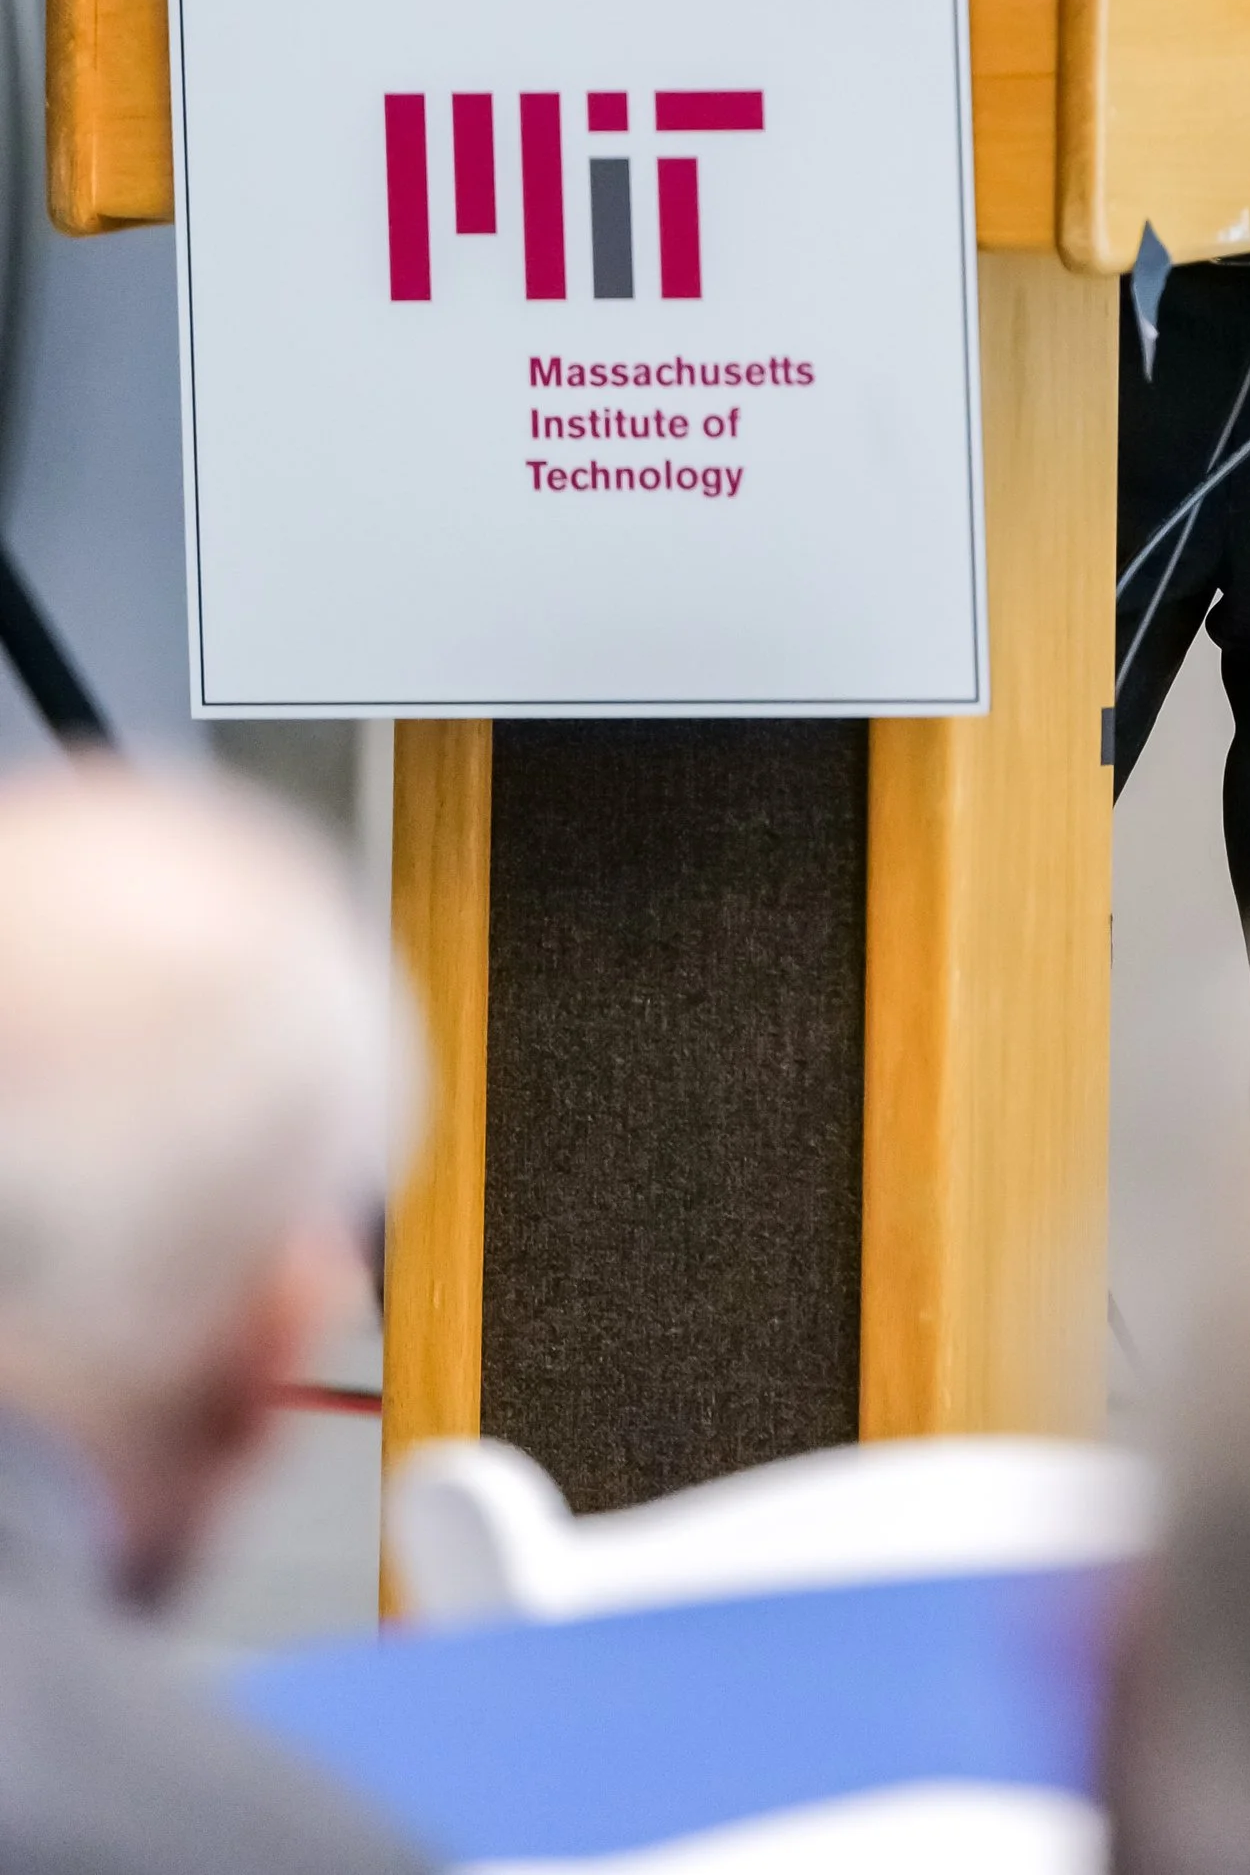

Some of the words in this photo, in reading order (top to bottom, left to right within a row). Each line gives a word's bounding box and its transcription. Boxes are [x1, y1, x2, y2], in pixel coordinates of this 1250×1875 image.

[527, 354, 817, 390] Massachusetts
[529, 406, 691, 442] Institute
[700, 405, 742, 441] of
[524, 457, 745, 500] Technology
